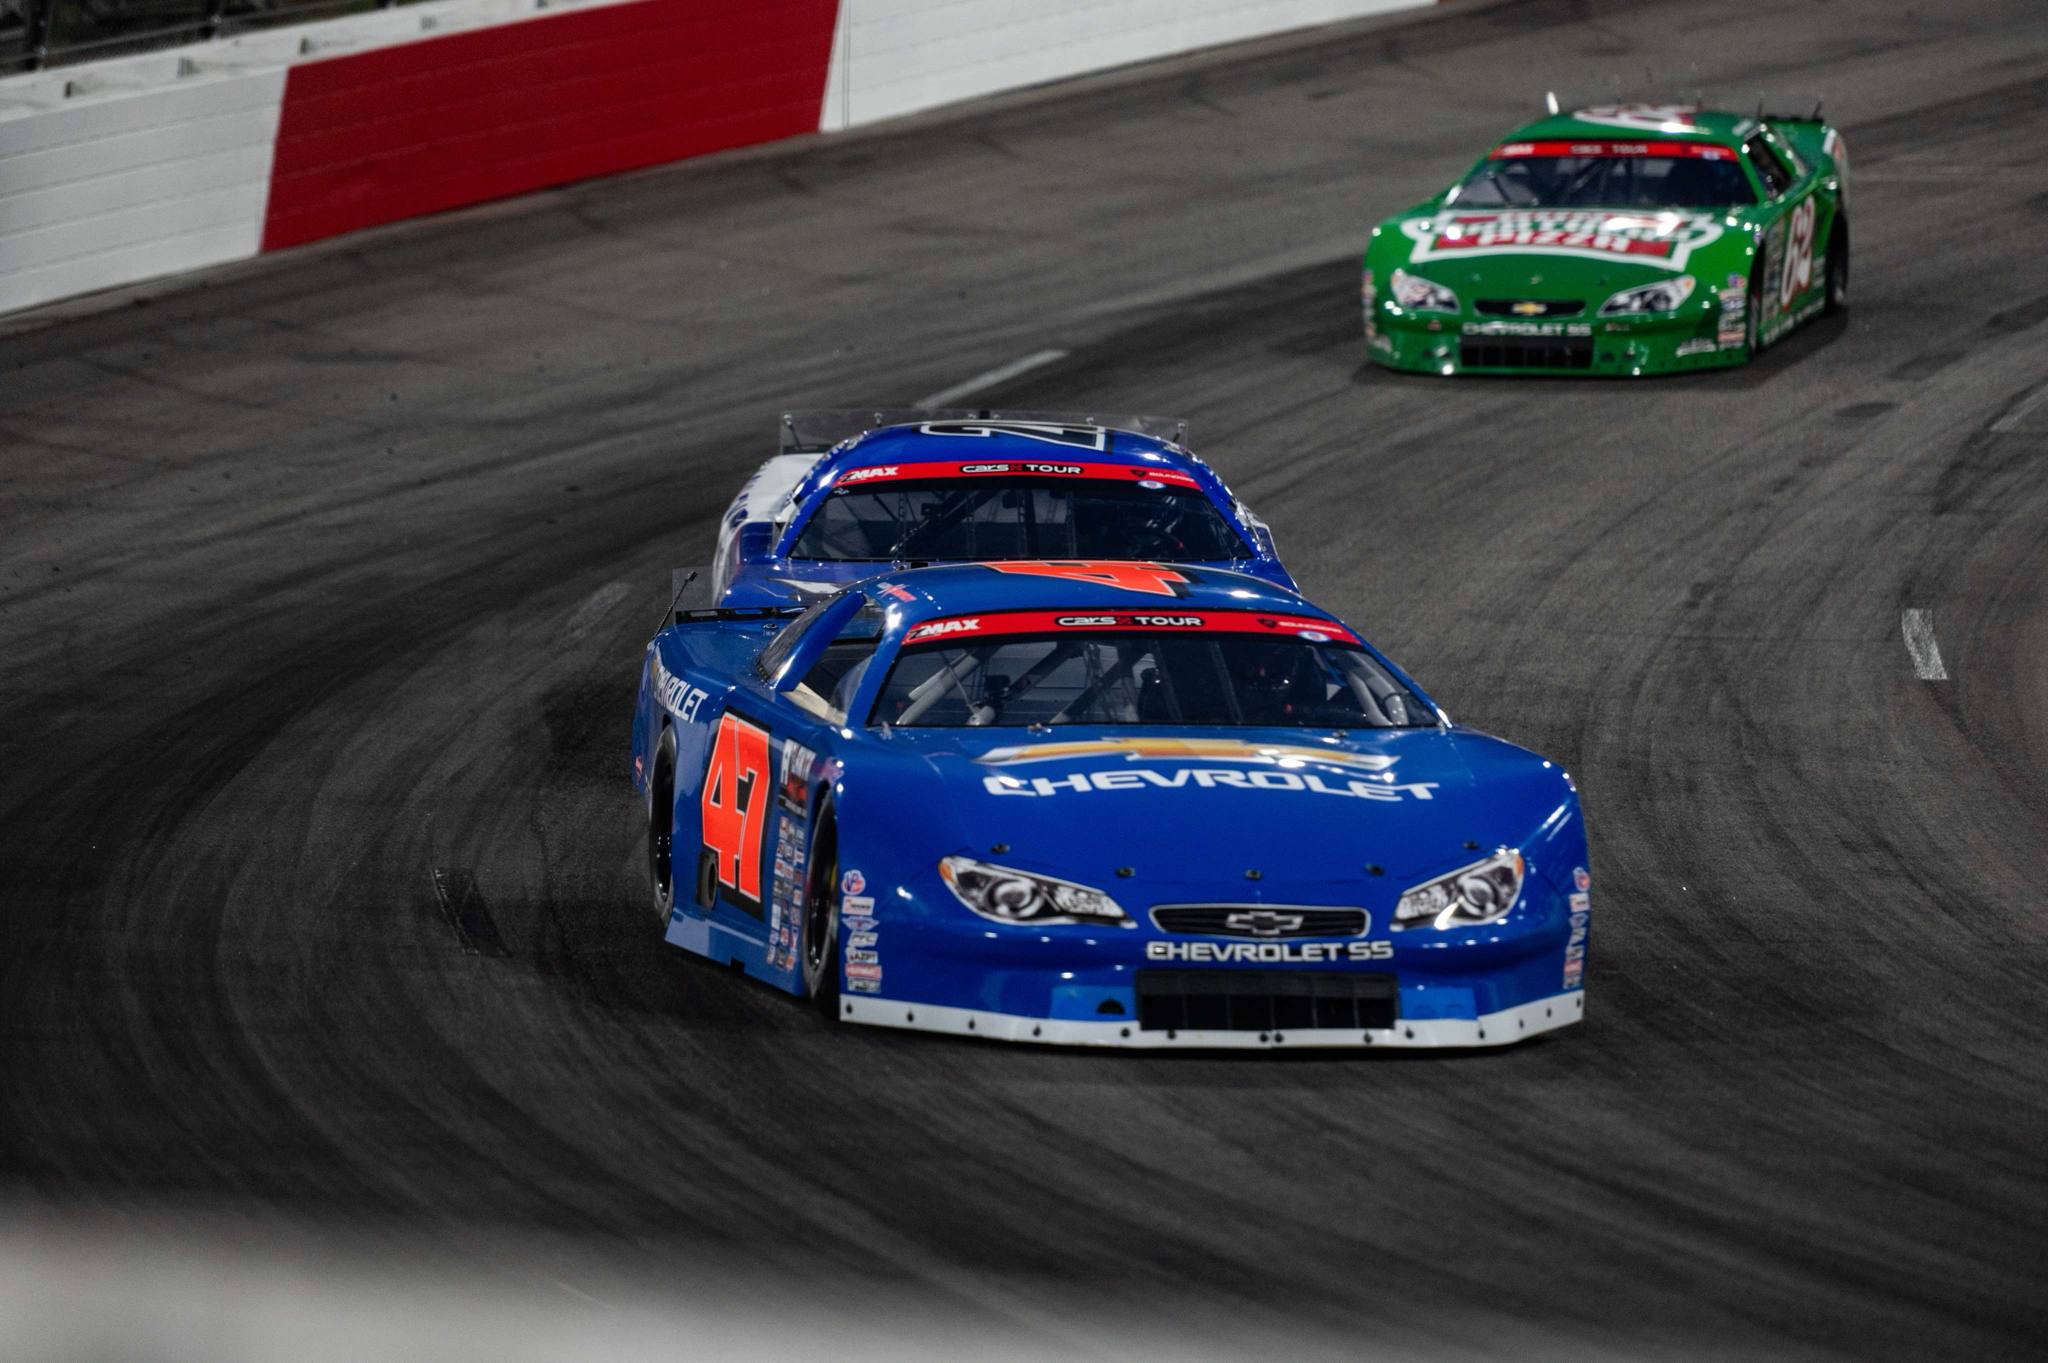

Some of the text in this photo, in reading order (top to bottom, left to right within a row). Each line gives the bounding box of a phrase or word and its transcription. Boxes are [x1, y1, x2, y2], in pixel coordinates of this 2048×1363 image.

[1026, 463, 1082, 475] TOUR
[1135, 616, 1203, 626] TOUR
[982, 768, 1440, 802] CHEVROLET
[702, 711, 770, 903] 47
[1147, 941, 1344, 963] CHEVROLET
